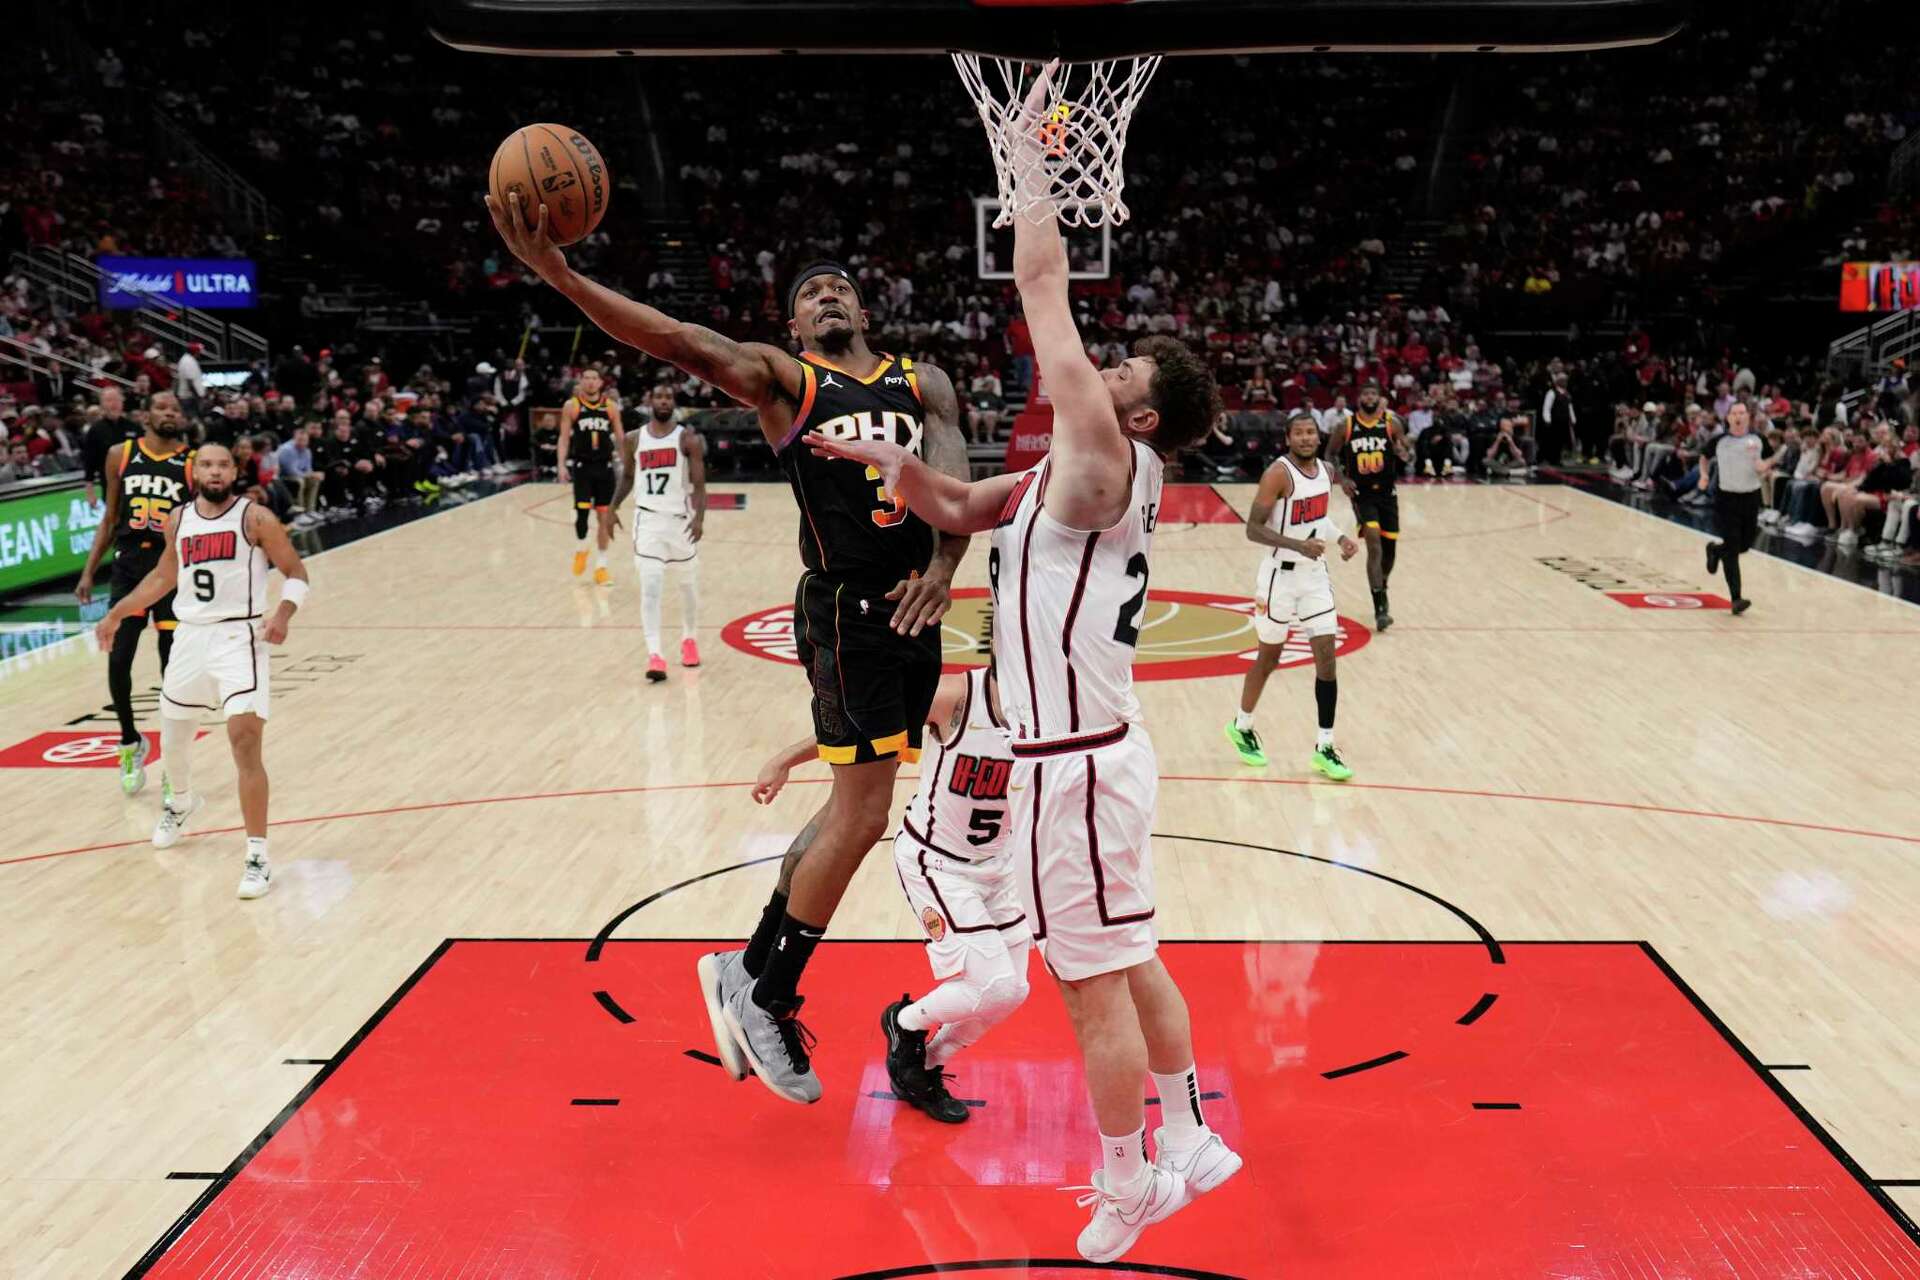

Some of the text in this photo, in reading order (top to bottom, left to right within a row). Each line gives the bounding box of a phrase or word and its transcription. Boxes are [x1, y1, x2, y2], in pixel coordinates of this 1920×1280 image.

[570, 133, 602, 212] Wilson
[186, 273, 251, 293] ULTRA
[578, 418, 610, 431] PHX
[815, 410, 924, 460] PHX
[591, 431, 600, 450] 1
[1351, 436, 1387, 453] PHX
[1356, 451, 1384, 475] 00
[124, 474, 184, 502] PHX
[646, 472, 669, 495] 17
[865, 464, 908, 527] 3
[129, 496, 172, 532] 35
[193, 568, 215, 602] 9
[966, 808, 1004, 846] 5
